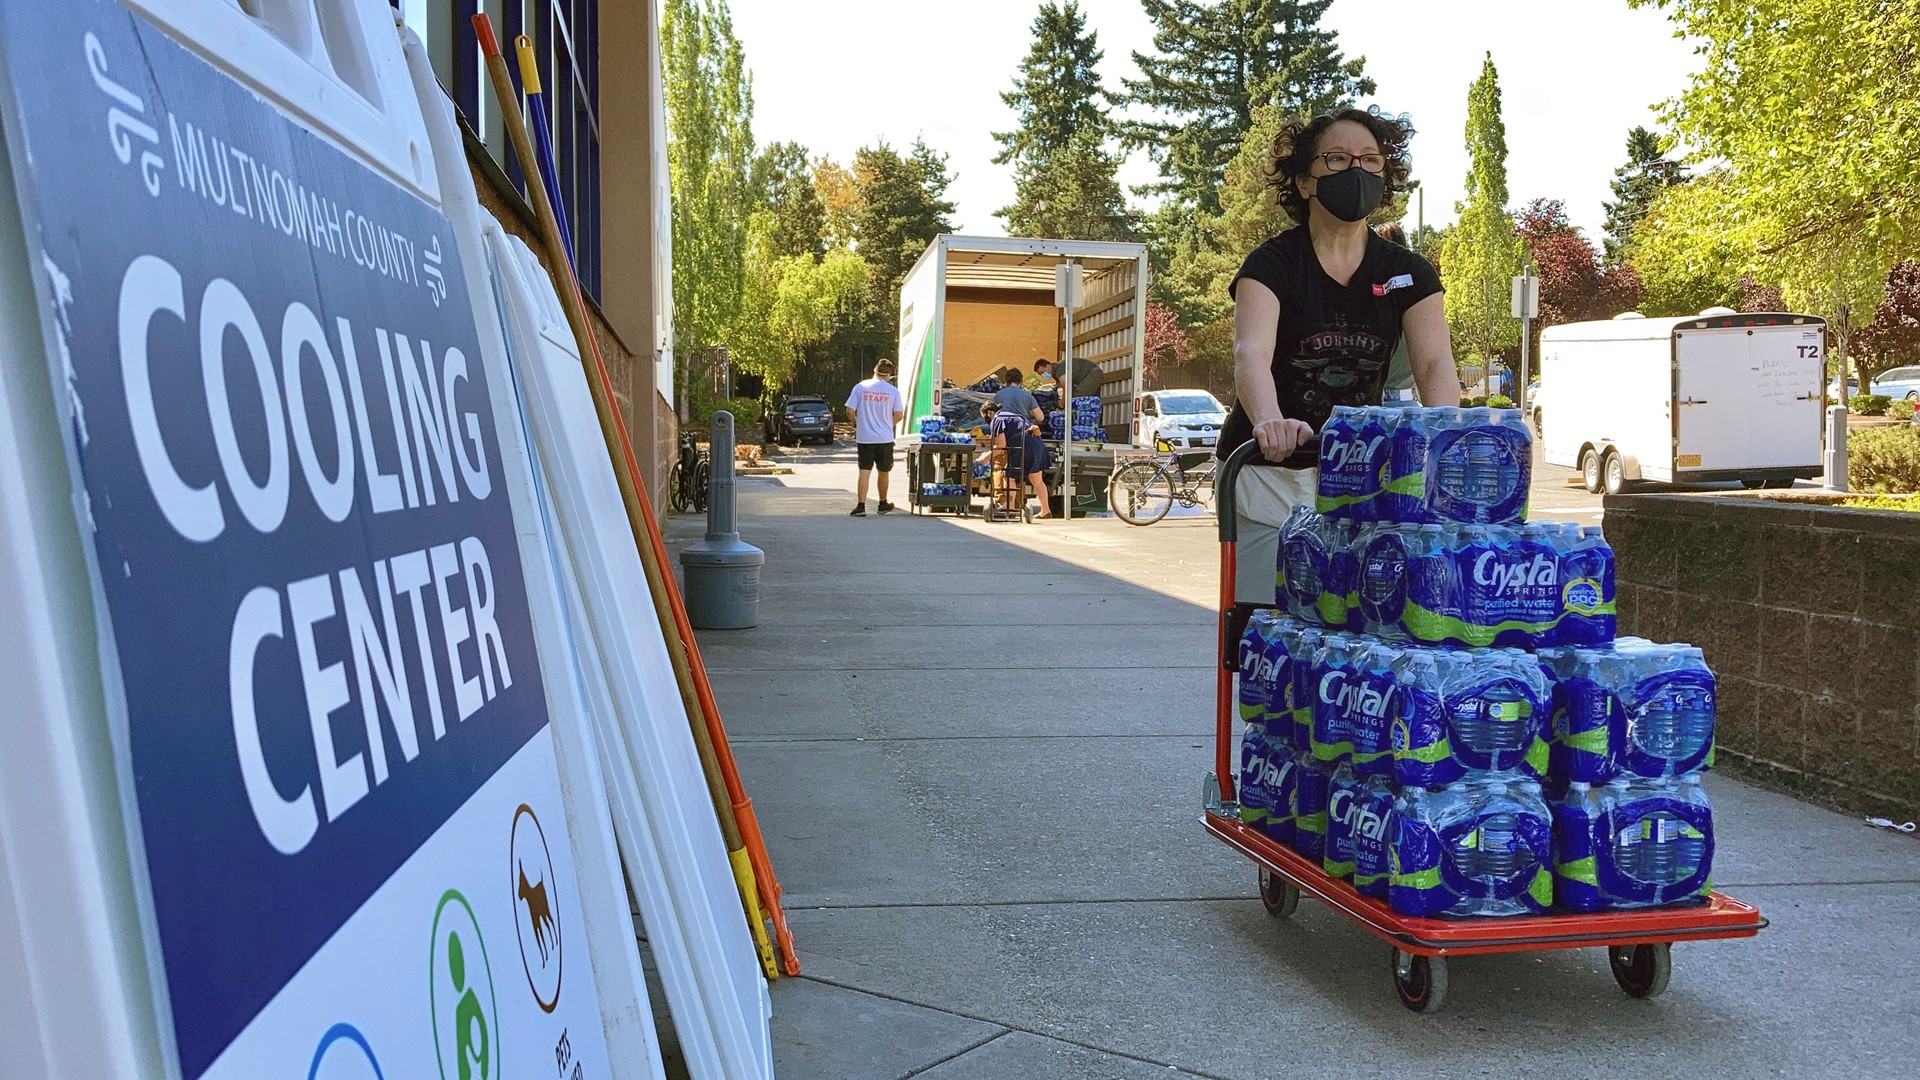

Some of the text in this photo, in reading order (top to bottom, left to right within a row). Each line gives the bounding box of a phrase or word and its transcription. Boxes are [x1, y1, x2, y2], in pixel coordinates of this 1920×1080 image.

[168, 111, 418, 288] MULTNOMAH COUNTY
[1313, 335, 1380, 351] JOHNNY
[1797, 345, 1818, 358] T2
[117, 254, 492, 543] COOLING
[863, 394, 889, 402] STAFF
[1473, 550, 1559, 597] Crystal
[229, 535, 513, 856] CENTER
[556, 1027, 571, 1078] PETS
